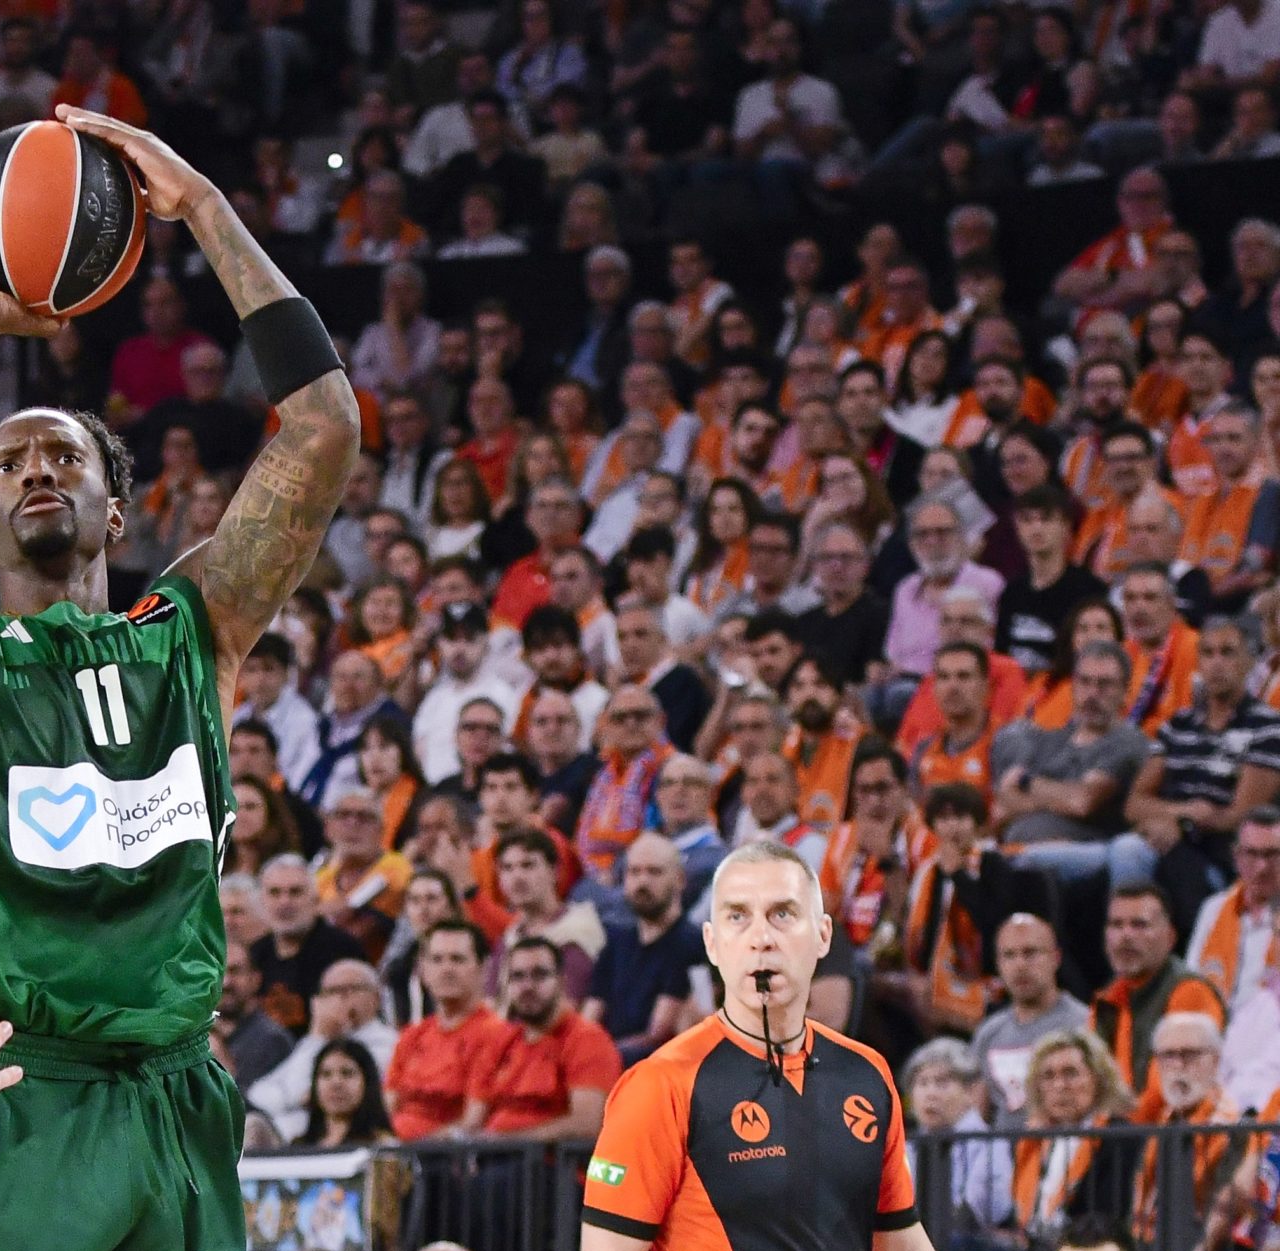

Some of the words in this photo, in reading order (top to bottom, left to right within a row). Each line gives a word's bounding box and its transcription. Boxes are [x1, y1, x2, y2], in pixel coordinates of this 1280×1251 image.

[75, 663, 131, 746] 11
[103, 785, 172, 825] Ομάδα
[728, 1145, 787, 1163] motorola
